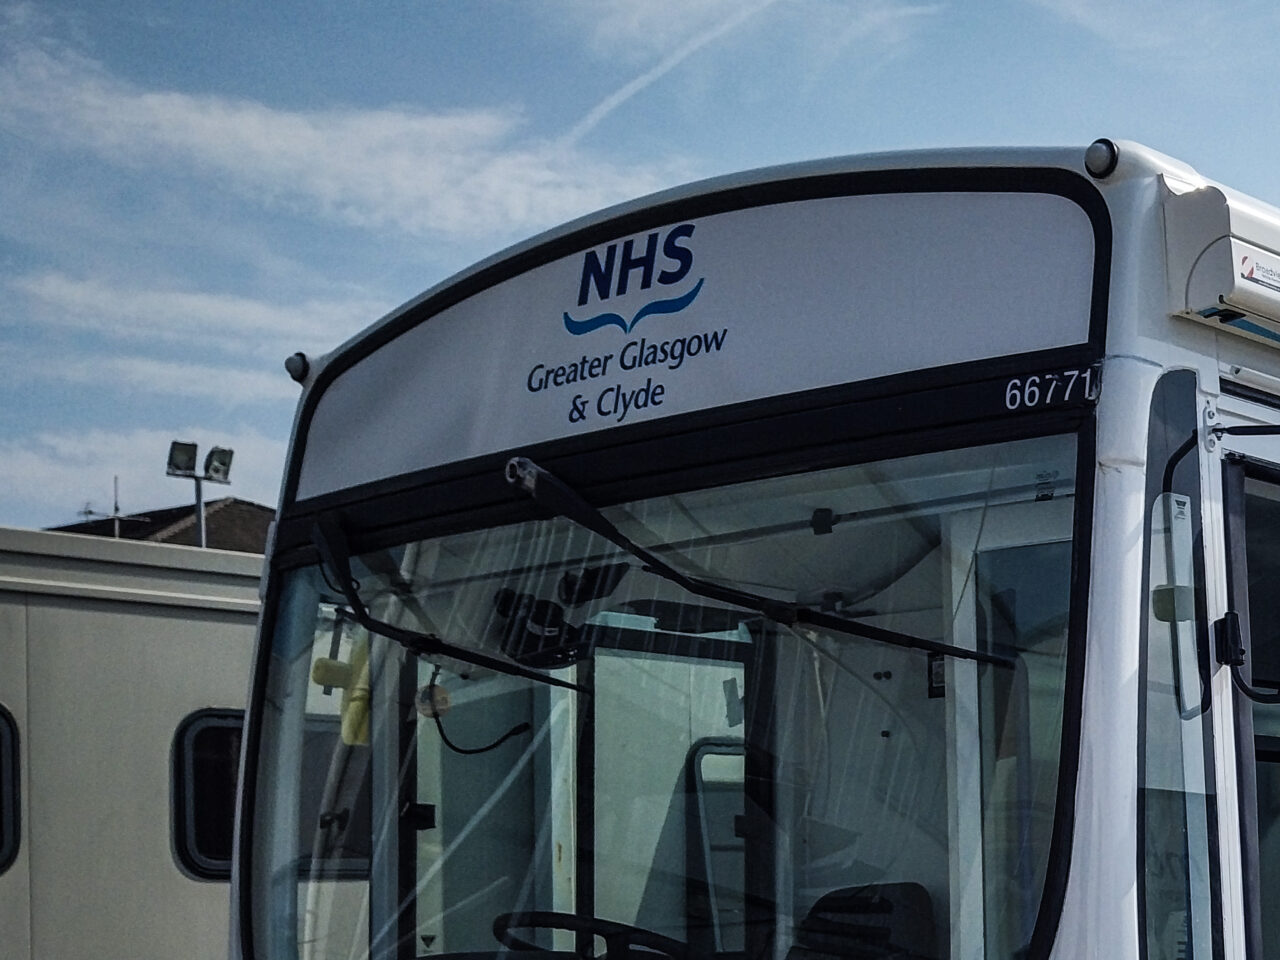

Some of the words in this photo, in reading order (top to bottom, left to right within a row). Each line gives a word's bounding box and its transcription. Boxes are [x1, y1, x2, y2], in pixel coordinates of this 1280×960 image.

[577, 223, 696, 307] NHS
[527, 352, 613, 393] Greater
[619, 328, 728, 370] Glasgow
[568, 394, 589, 423] &
[596, 377, 666, 423] Clyde
[1005, 367, 1093, 410] 66771
